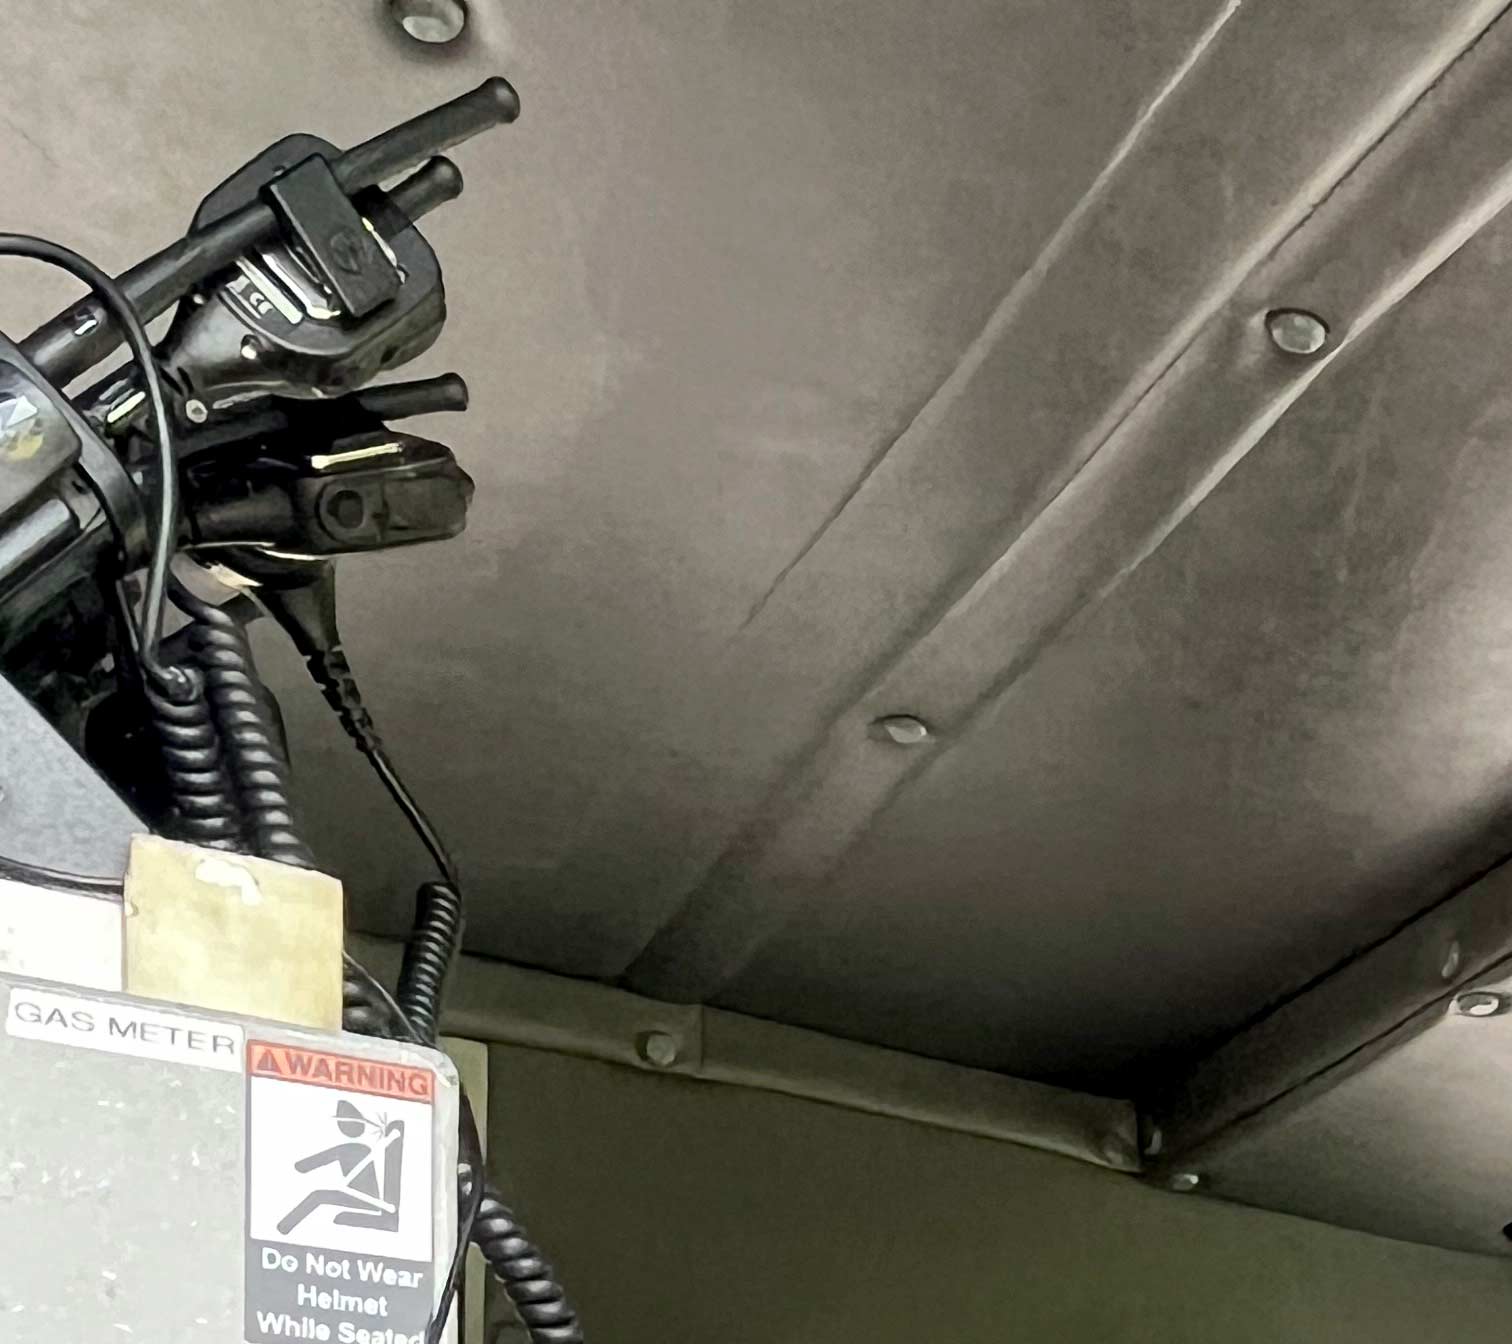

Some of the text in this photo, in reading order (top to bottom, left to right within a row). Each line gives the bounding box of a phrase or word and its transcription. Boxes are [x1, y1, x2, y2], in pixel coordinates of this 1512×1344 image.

[14, 1001, 235, 1055] GAS METER
[286, 1050, 428, 1096] WARNING
[261, 1246, 424, 1289] Do Not Wear
[297, 1283, 388, 1317] Helmet
[256, 1310, 331, 1342] While
